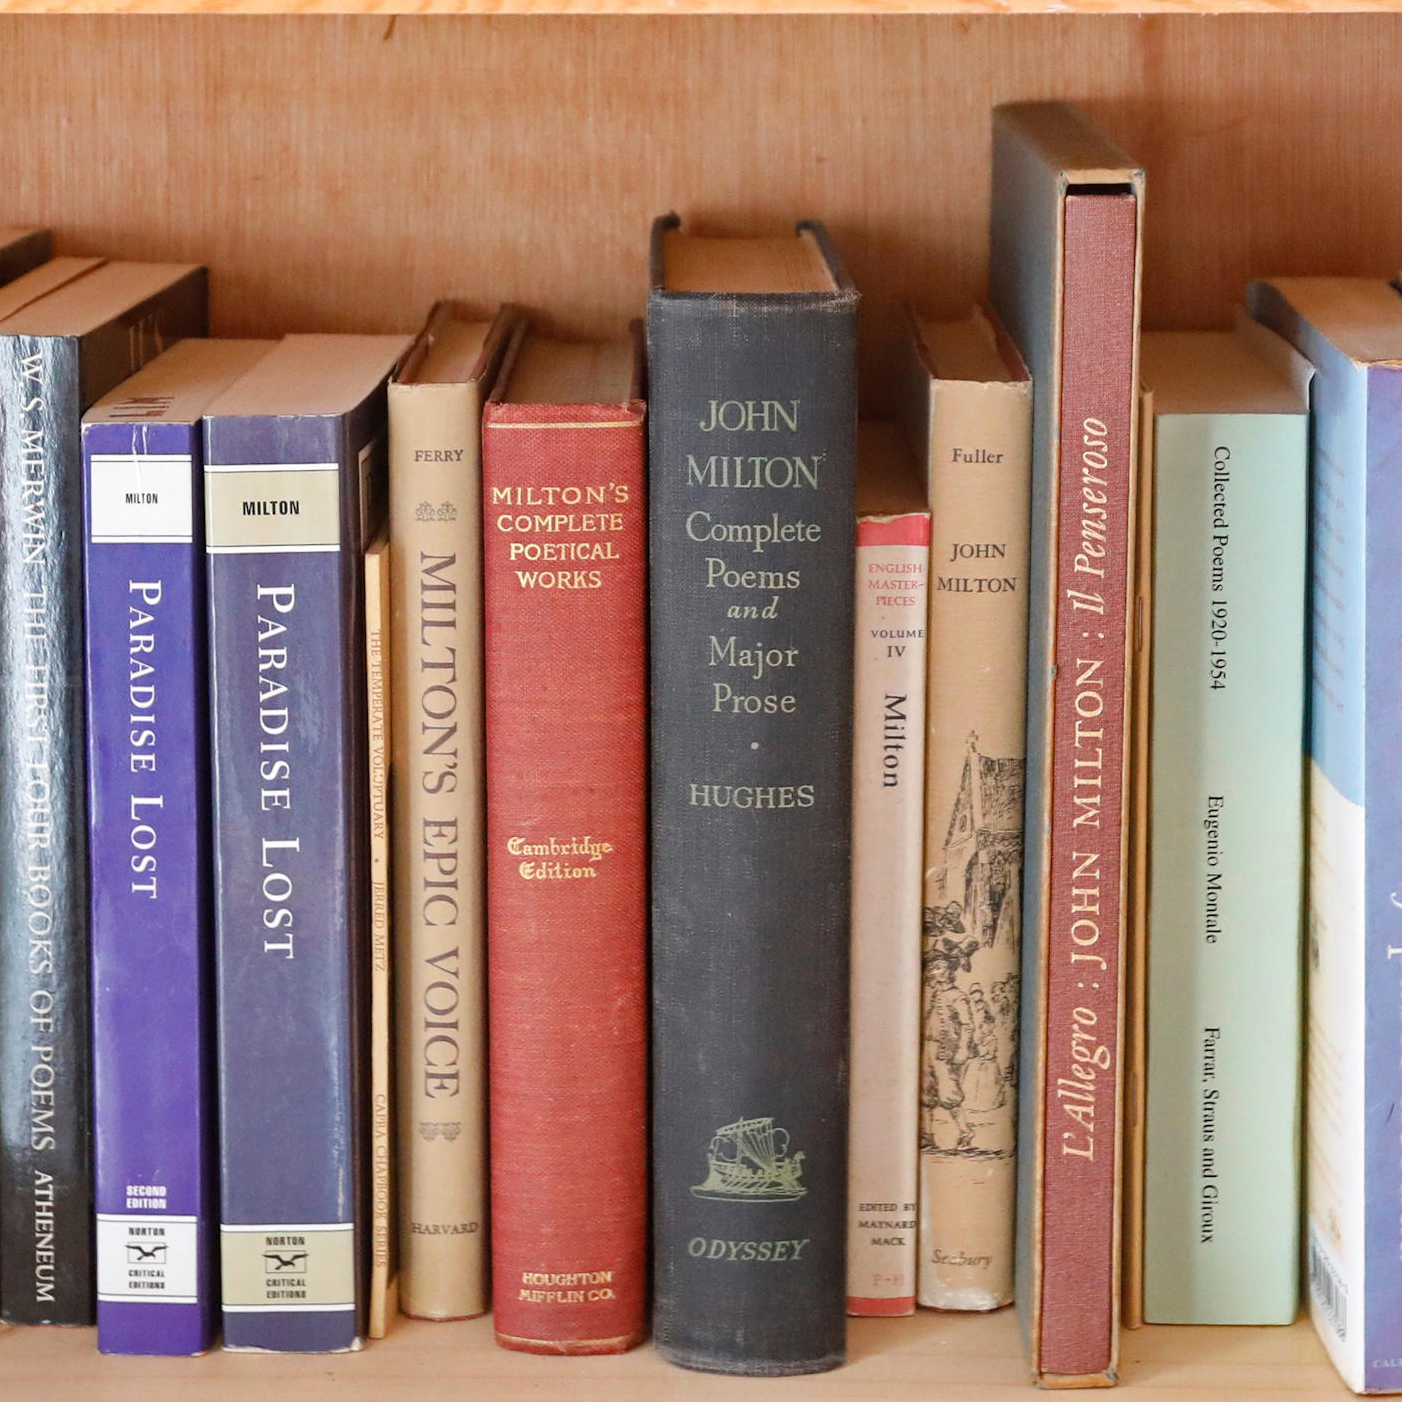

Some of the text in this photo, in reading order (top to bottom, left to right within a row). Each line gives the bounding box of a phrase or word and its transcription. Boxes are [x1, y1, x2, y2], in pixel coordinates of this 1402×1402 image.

[699, 400, 800, 431] JOHN
[415, 449, 464, 461] FERRY
[952, 448, 1004, 463] Fuller
[686, 454, 819, 489] MILTON
[126, 494, 157, 504] MILTON
[243, 501, 299, 515] MILTON
[1073, 416, 1109, 576] Penseroso
[497, 514, 623, 532] COMPLETE
[686, 511, 820, 552] Complete
[510, 542, 619, 560] POETICAL
[950, 544, 1006, 562] JOHN
[515, 571, 601, 589] WORKS
[705, 558, 799, 589] Poems
[1210, 446, 1230, 689] Collected Poems 1920-1954
[936, 576, 1017, 592] MILTON
[726, 605, 778, 619] and
[708, 635, 798, 679] Major
[713, 683, 795, 713] Prose
[884, 694, 906, 787] Milton
[1073, 658, 1104, 829] MILTON
[689, 784, 814, 808] HUGHES
[423, 817, 458, 926] EPIC
[1204, 797, 1223, 943] Eugenio Montale
[1070, 850, 1107, 970] JOHN
[425, 946, 460, 1098] VOICE
[1202, 1029, 1219, 1242] Farrar, Straus and Giroux
[35, 1170, 54, 1301] ATHENEUM
[688, 1237, 809, 1261] ODYSSEY
